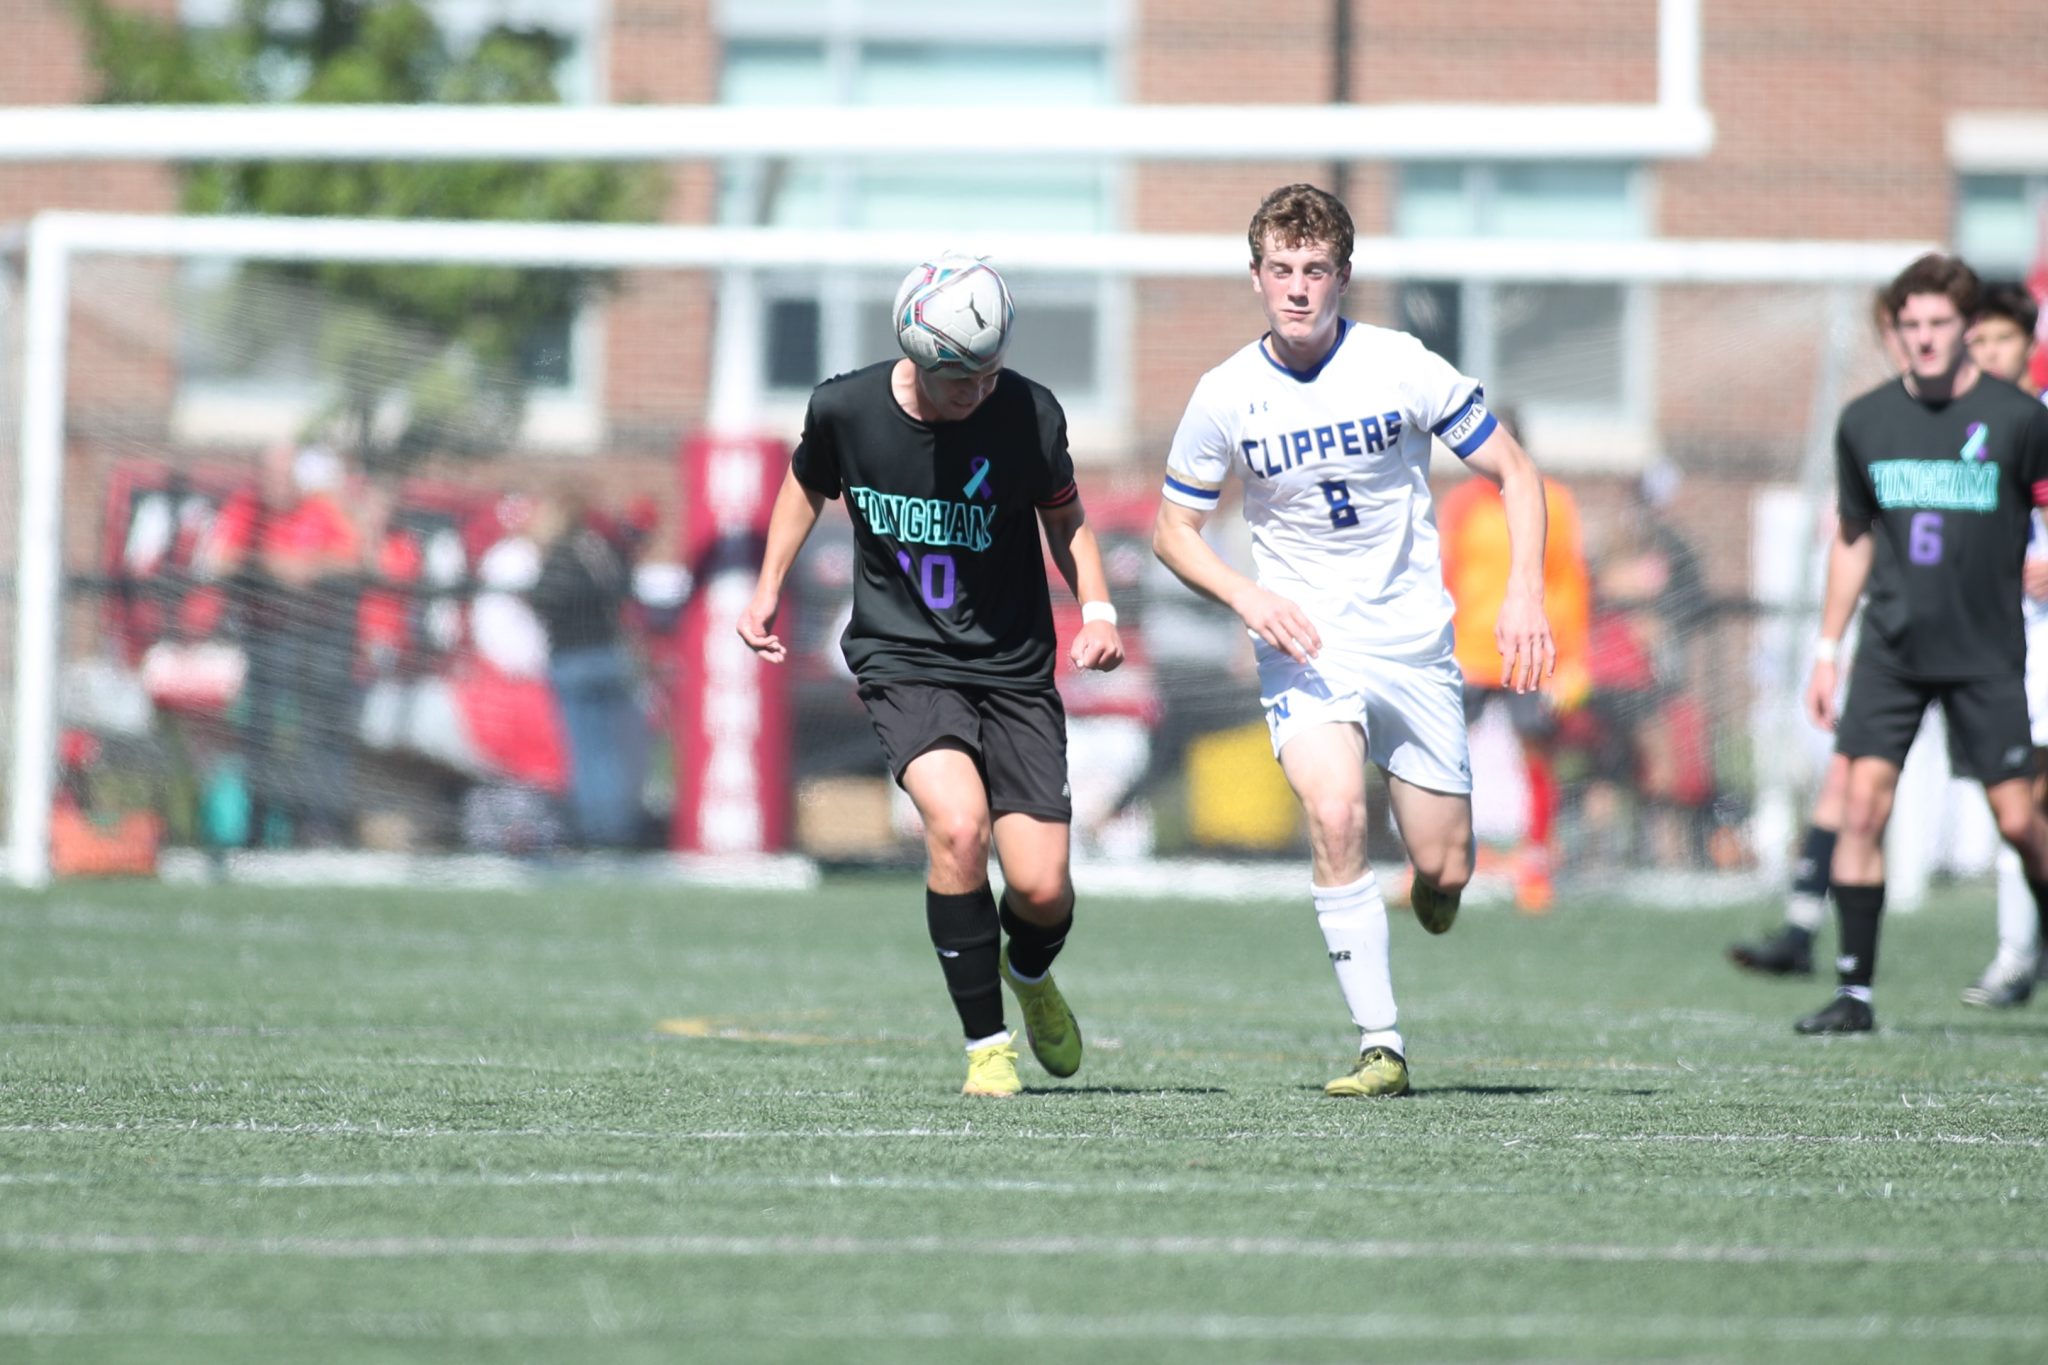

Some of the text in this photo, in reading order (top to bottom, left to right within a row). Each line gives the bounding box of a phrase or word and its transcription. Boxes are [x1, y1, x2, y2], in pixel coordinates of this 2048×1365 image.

[1241, 411, 1402, 479] CLIPPERS
[1317, 480, 1360, 529] 8
[1908, 511, 1944, 566] 6
